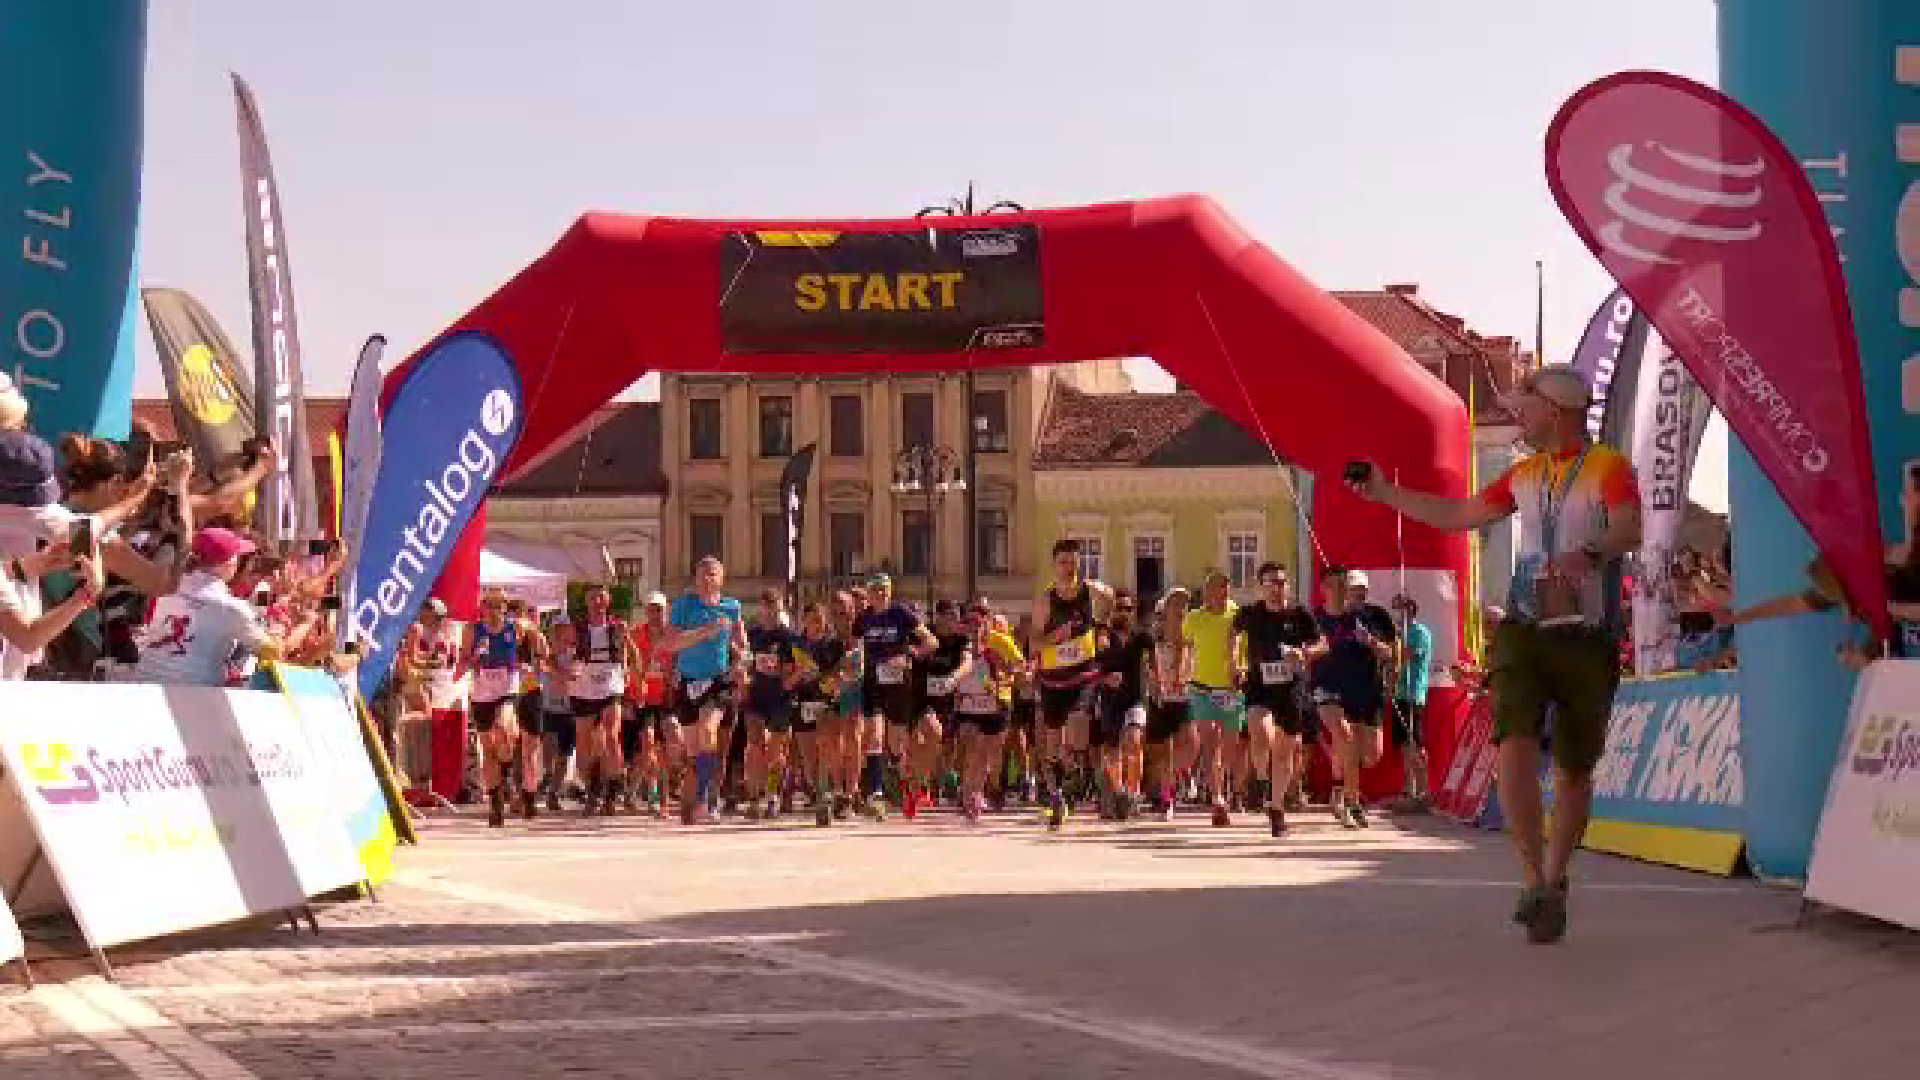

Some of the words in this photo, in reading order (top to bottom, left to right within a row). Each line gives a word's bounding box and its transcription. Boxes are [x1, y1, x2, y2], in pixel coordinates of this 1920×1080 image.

[24, 150, 72, 270] FLY
[794, 271, 963, 312] START
[15, 308, 64, 393] TO
[354, 429, 496, 652] Pentalog
